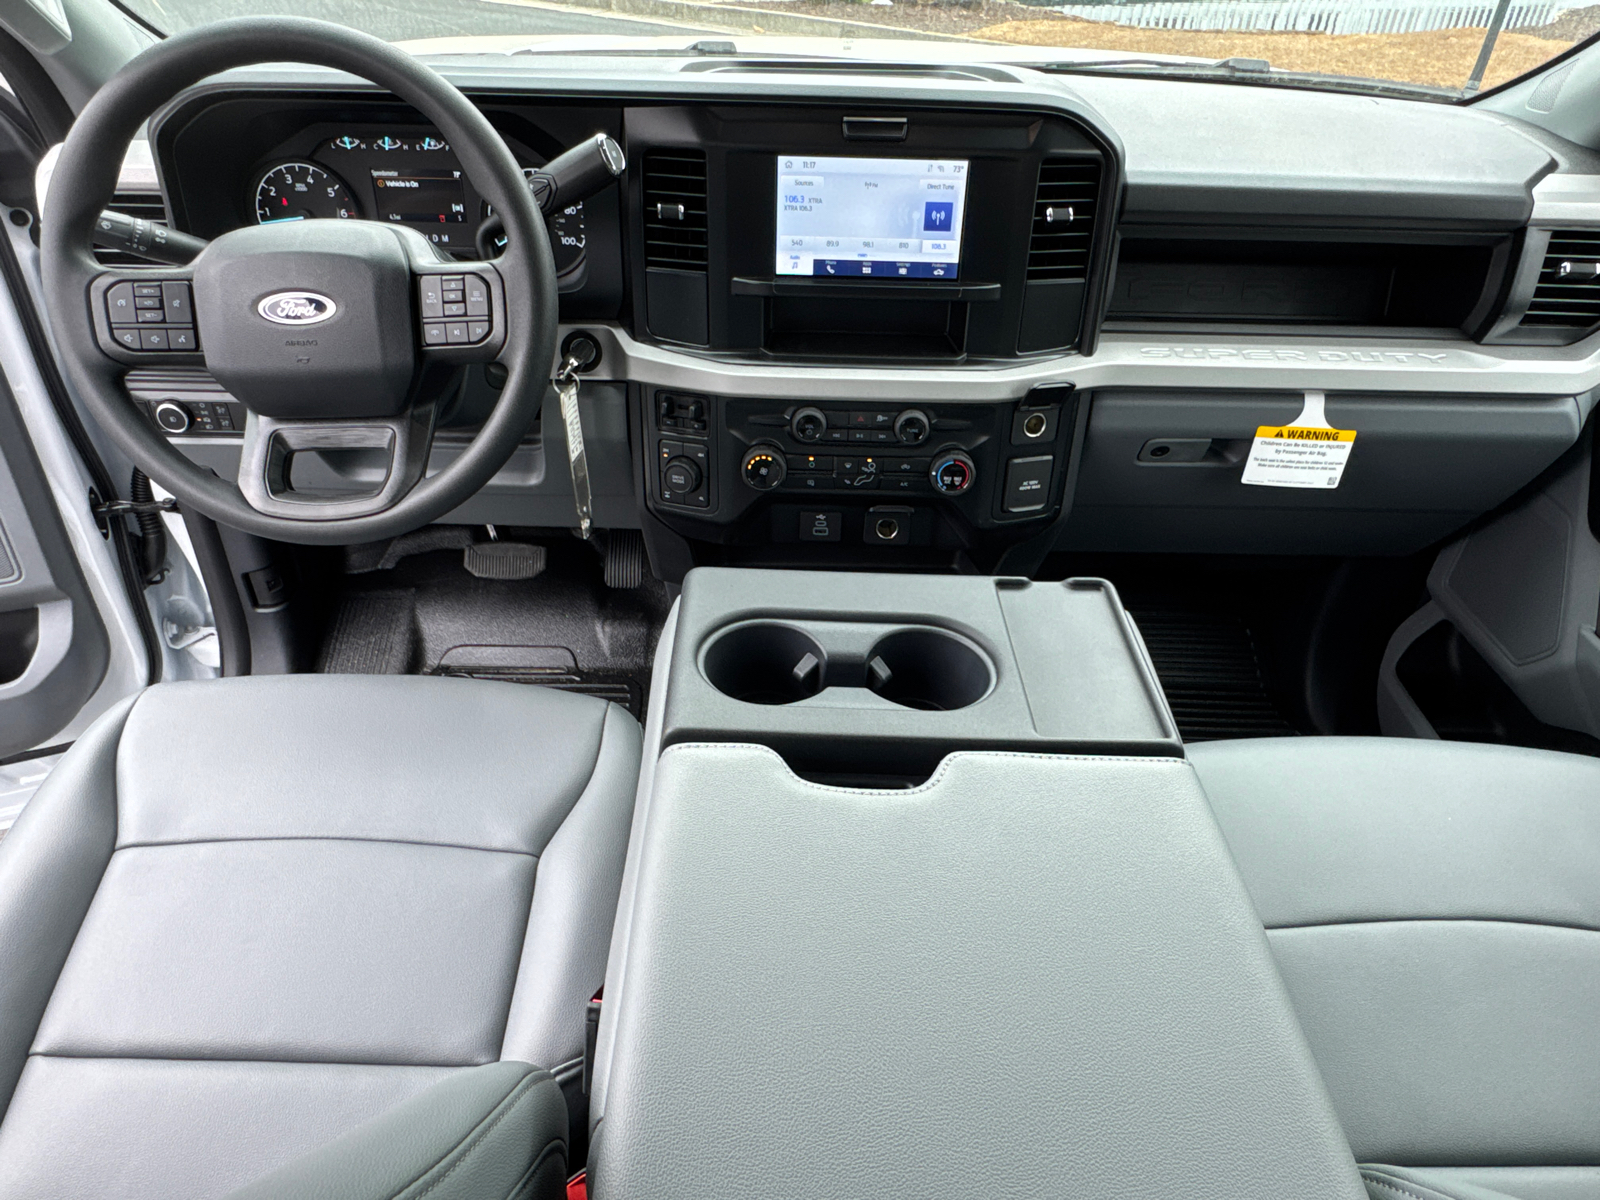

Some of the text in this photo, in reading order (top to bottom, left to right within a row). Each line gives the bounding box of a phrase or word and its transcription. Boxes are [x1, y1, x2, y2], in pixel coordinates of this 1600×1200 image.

[285, 174, 292, 184] 3
[307, 175, 314, 184] 4
[269, 186, 276, 196] 2
[327, 187, 335, 197] 5
[784, 195, 805, 203] 106.3
[265, 207, 270, 216] 1
[340, 209, 348, 218] 6
[277, 299, 316, 316] Ford
[1140, 347, 1447, 364] SUPER DUTY
[1287, 430, 1340, 441] WARNING
